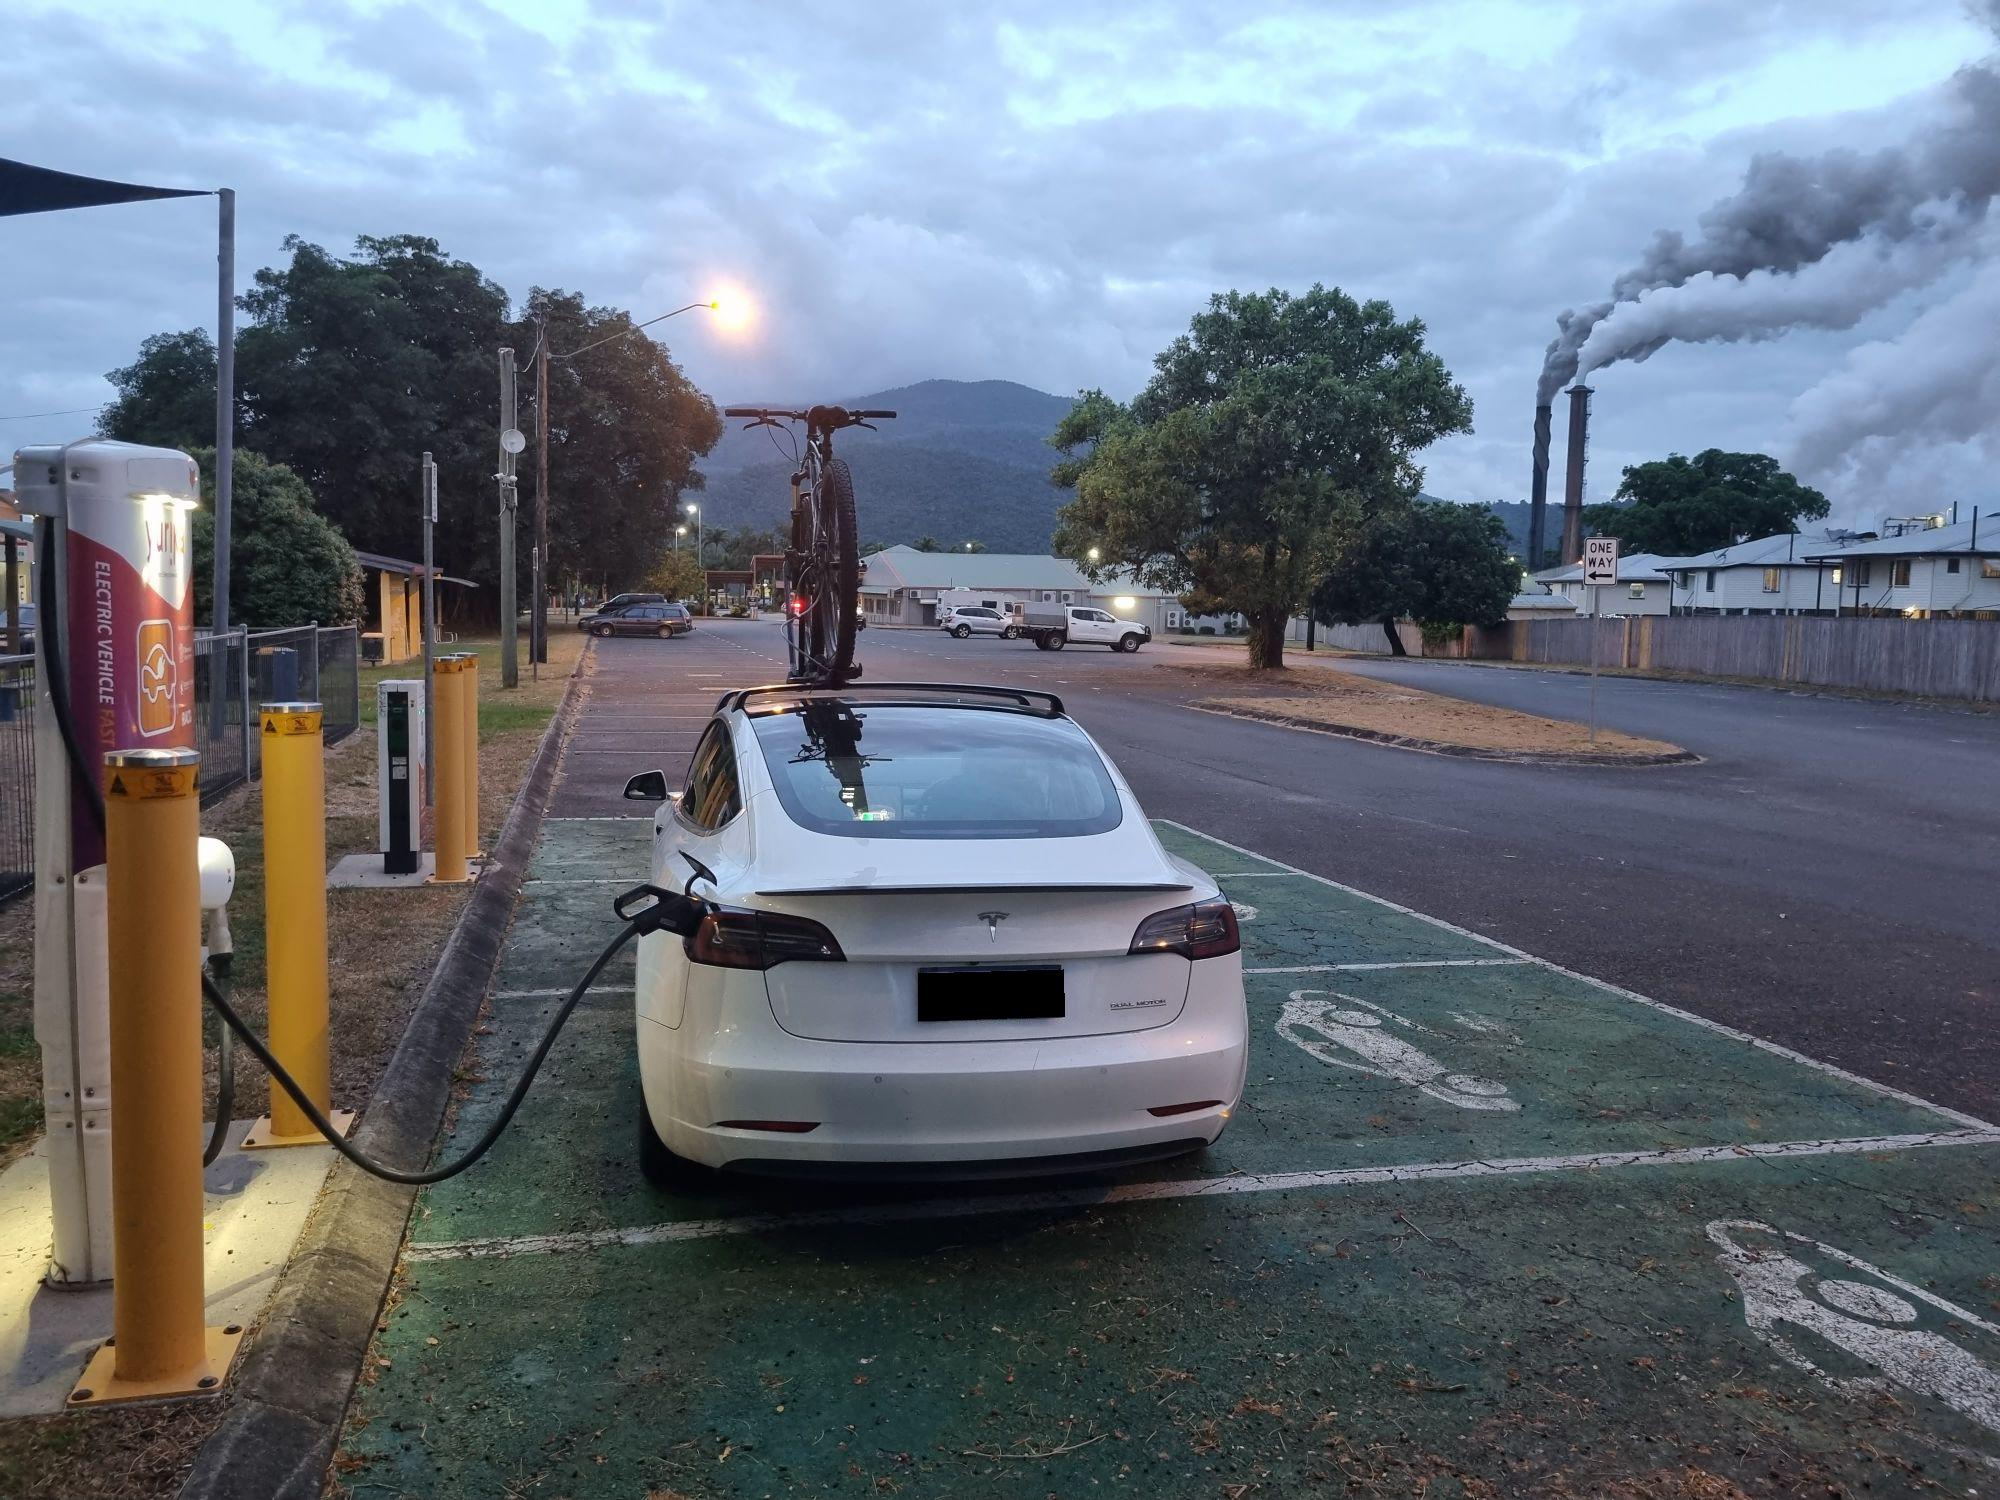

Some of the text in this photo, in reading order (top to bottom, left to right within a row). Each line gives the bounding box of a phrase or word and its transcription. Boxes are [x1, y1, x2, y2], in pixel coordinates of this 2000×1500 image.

[1590, 542, 1612, 554] ONE
[1588, 556, 1614, 568] WAY
[95, 560, 116, 748] ELECTRIC VEHICLE FAST
